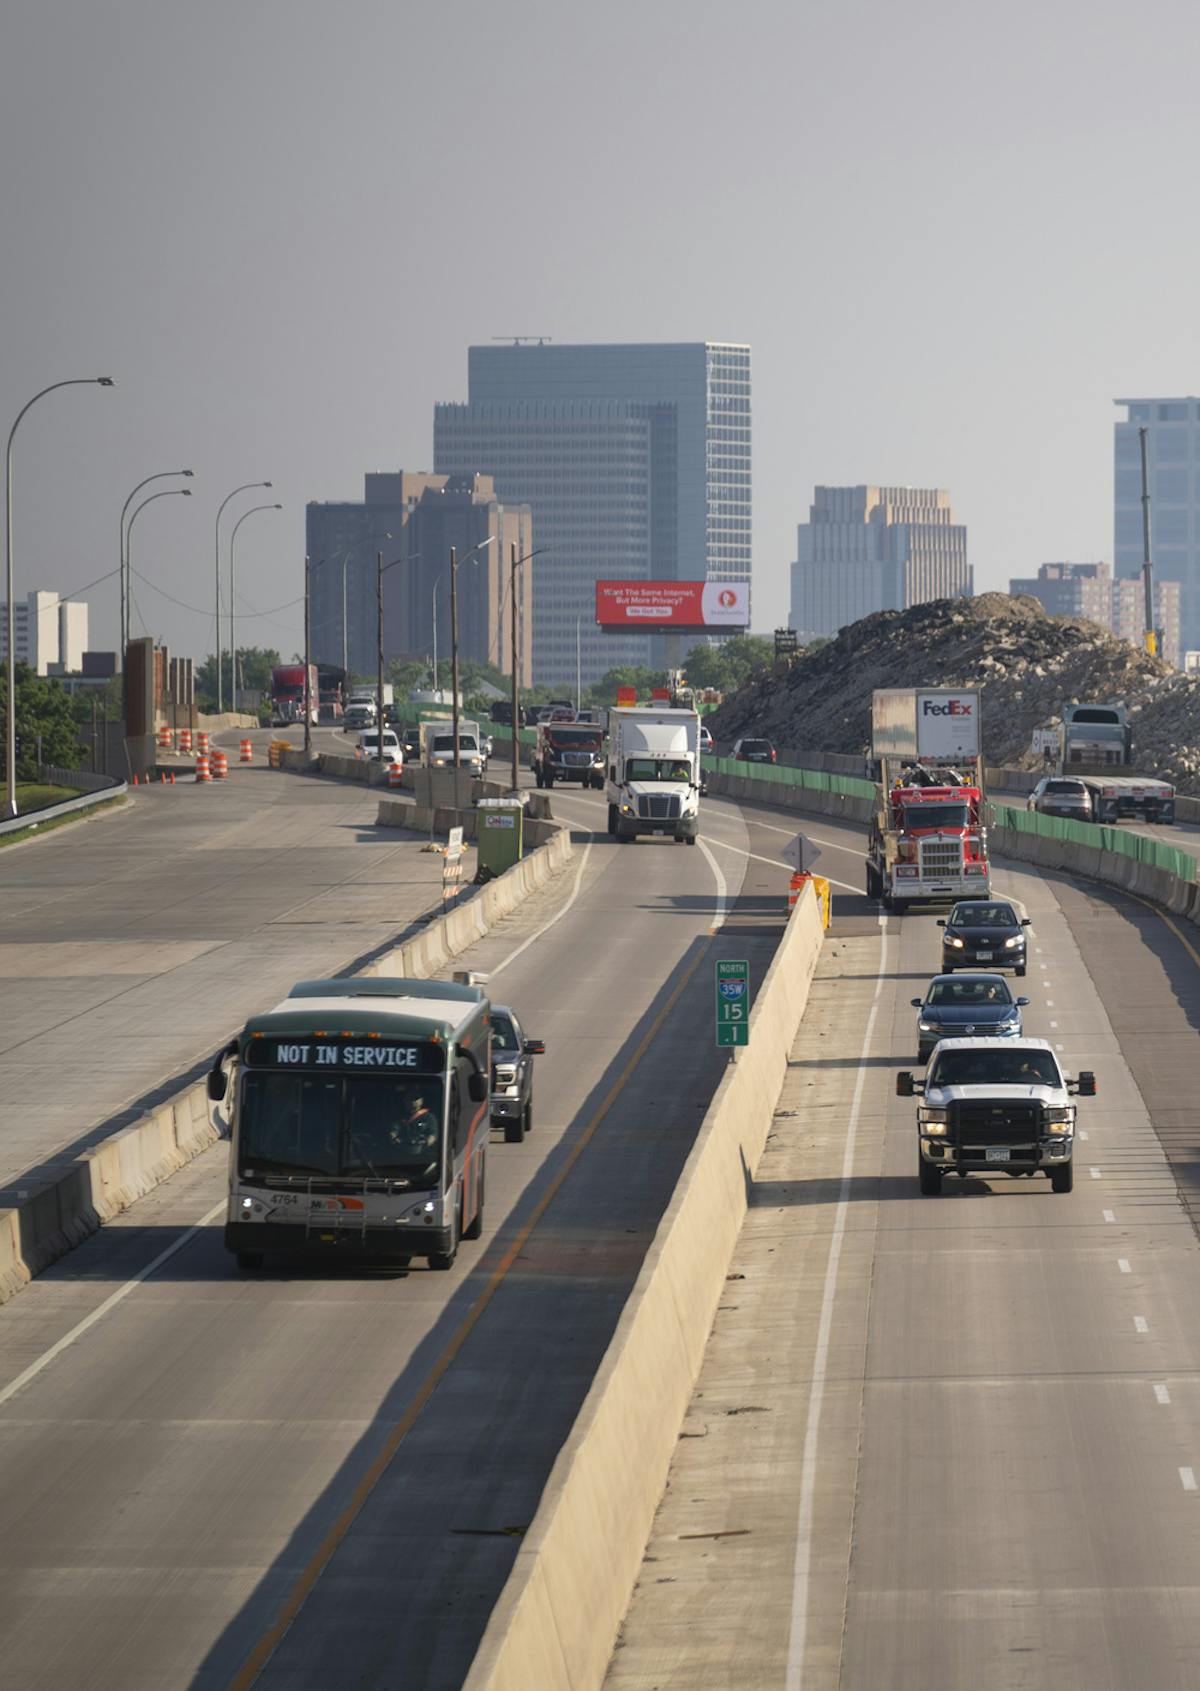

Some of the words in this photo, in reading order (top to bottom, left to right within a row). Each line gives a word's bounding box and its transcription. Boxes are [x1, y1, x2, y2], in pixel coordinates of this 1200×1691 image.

[603, 588, 624, 596] Want
[625, 588, 639, 596] The
[640, 588, 662, 596] Same
[923, 700, 973, 716] FedEx
[719, 964, 745, 973] NORTH
[722, 984, 743, 995] 35W
[723, 1003, 742, 1020] 15
[277, 1044, 311, 1064] NOT
[316, 1045, 338, 1065] IN
[343, 1046, 418, 1067] SERVICE
[270, 1194, 299, 1205] 4764
